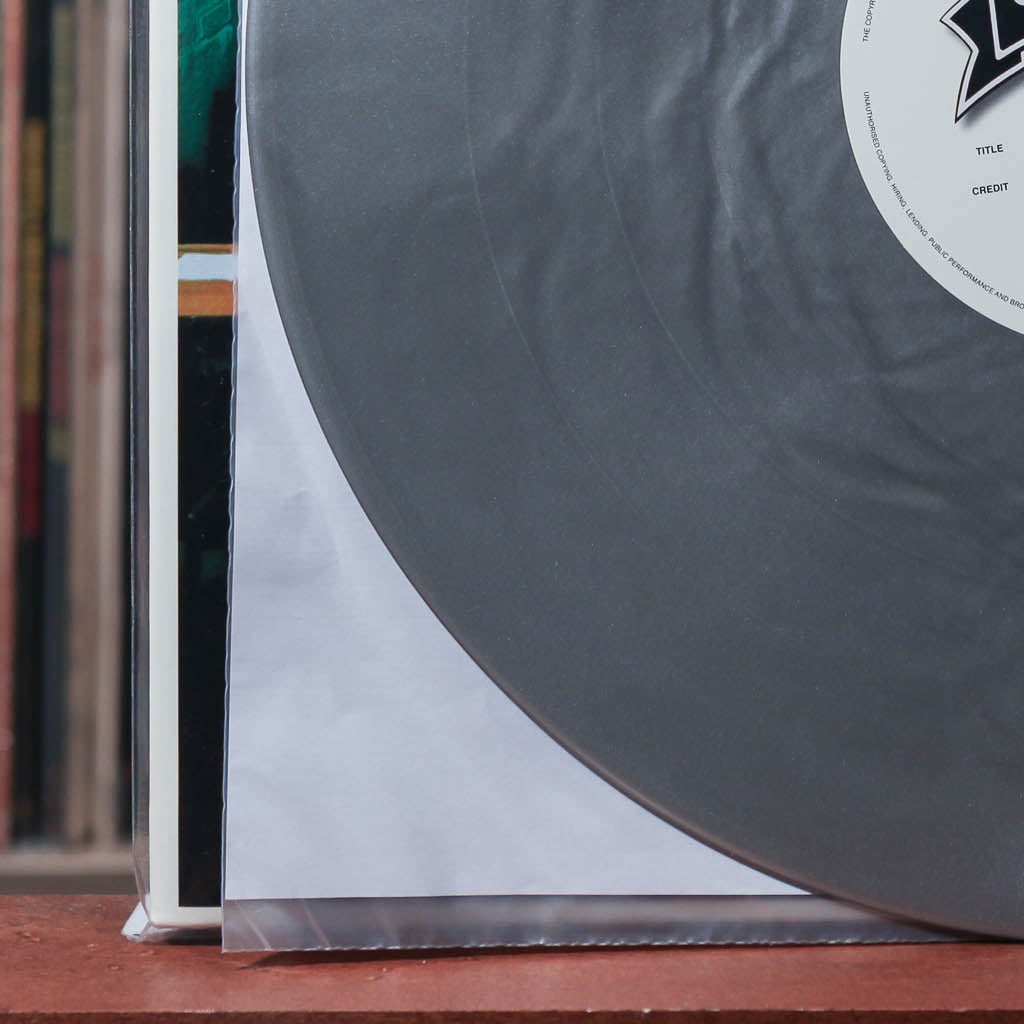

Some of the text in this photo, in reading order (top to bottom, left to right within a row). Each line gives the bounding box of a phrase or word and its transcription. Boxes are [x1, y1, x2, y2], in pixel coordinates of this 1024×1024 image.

[975, 143, 1004, 156] TITLE
[864, 91, 880, 148] UNAUTHORISED
[928, 237, 949, 258] PUBLIC
[948, 257, 995, 294] PERFORMANCE
[994, 291, 1009, 302] AND
[972, 182, 1009, 197] CREDIT
